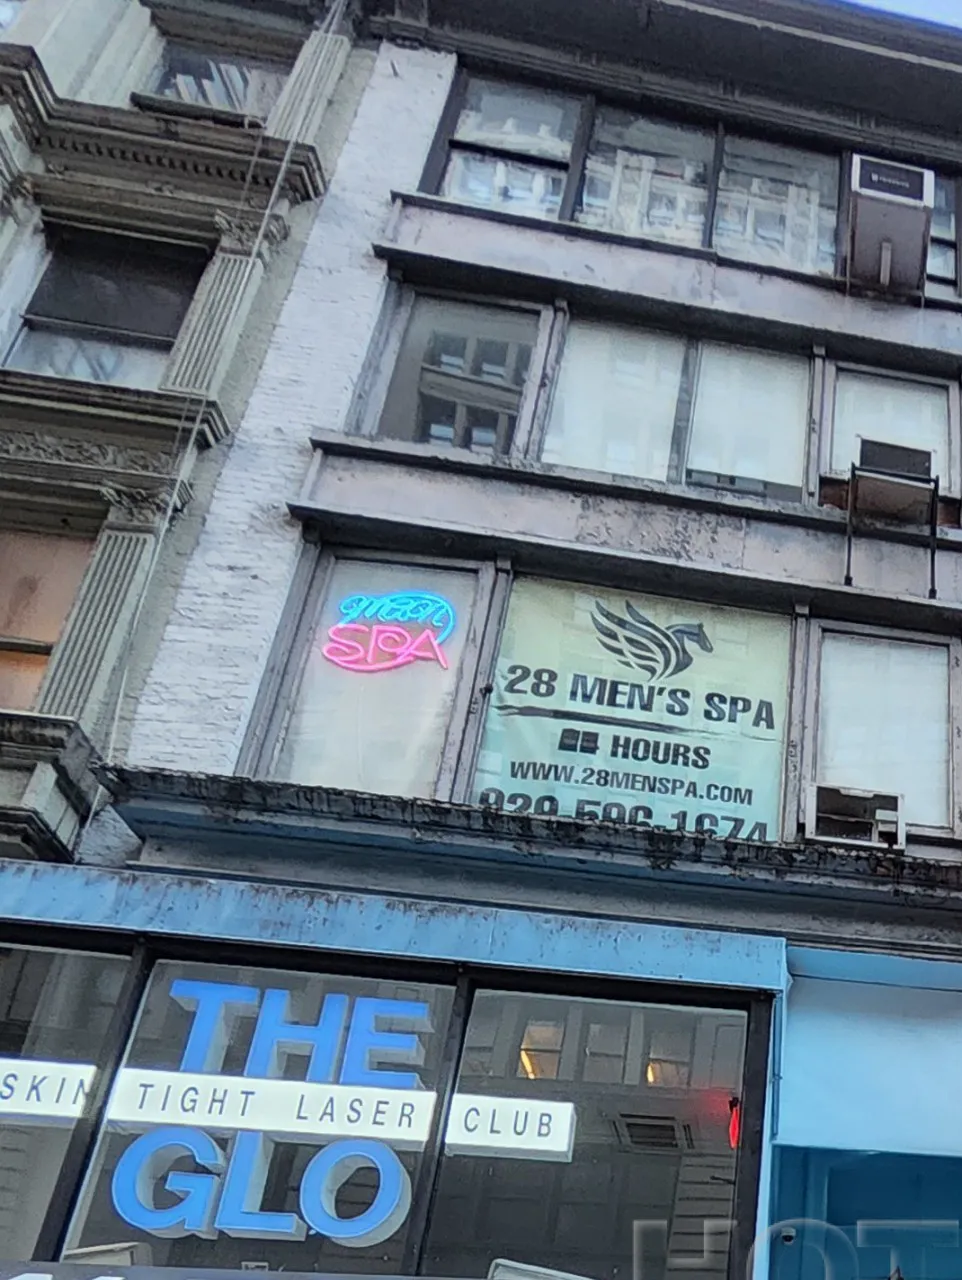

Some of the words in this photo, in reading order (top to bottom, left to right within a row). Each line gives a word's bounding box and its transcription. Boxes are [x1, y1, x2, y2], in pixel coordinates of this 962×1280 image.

[322, 623, 448, 672] SPA
[503, 664, 557, 699] 28
[570, 672, 690, 717] MEN'S
[704, 692, 774, 731] SPA
[610, 734, 711, 770] HOURS
[510, 761, 753, 806] WWW.28MENSPA.COM
[168, 979, 433, 1089] THE
[137, 1083, 256, 1117] TIGHT
[296, 1092, 415, 1129] LASER
[463, 1107, 554, 1138] CLUB
[111, 1126, 408, 1245] GLO
